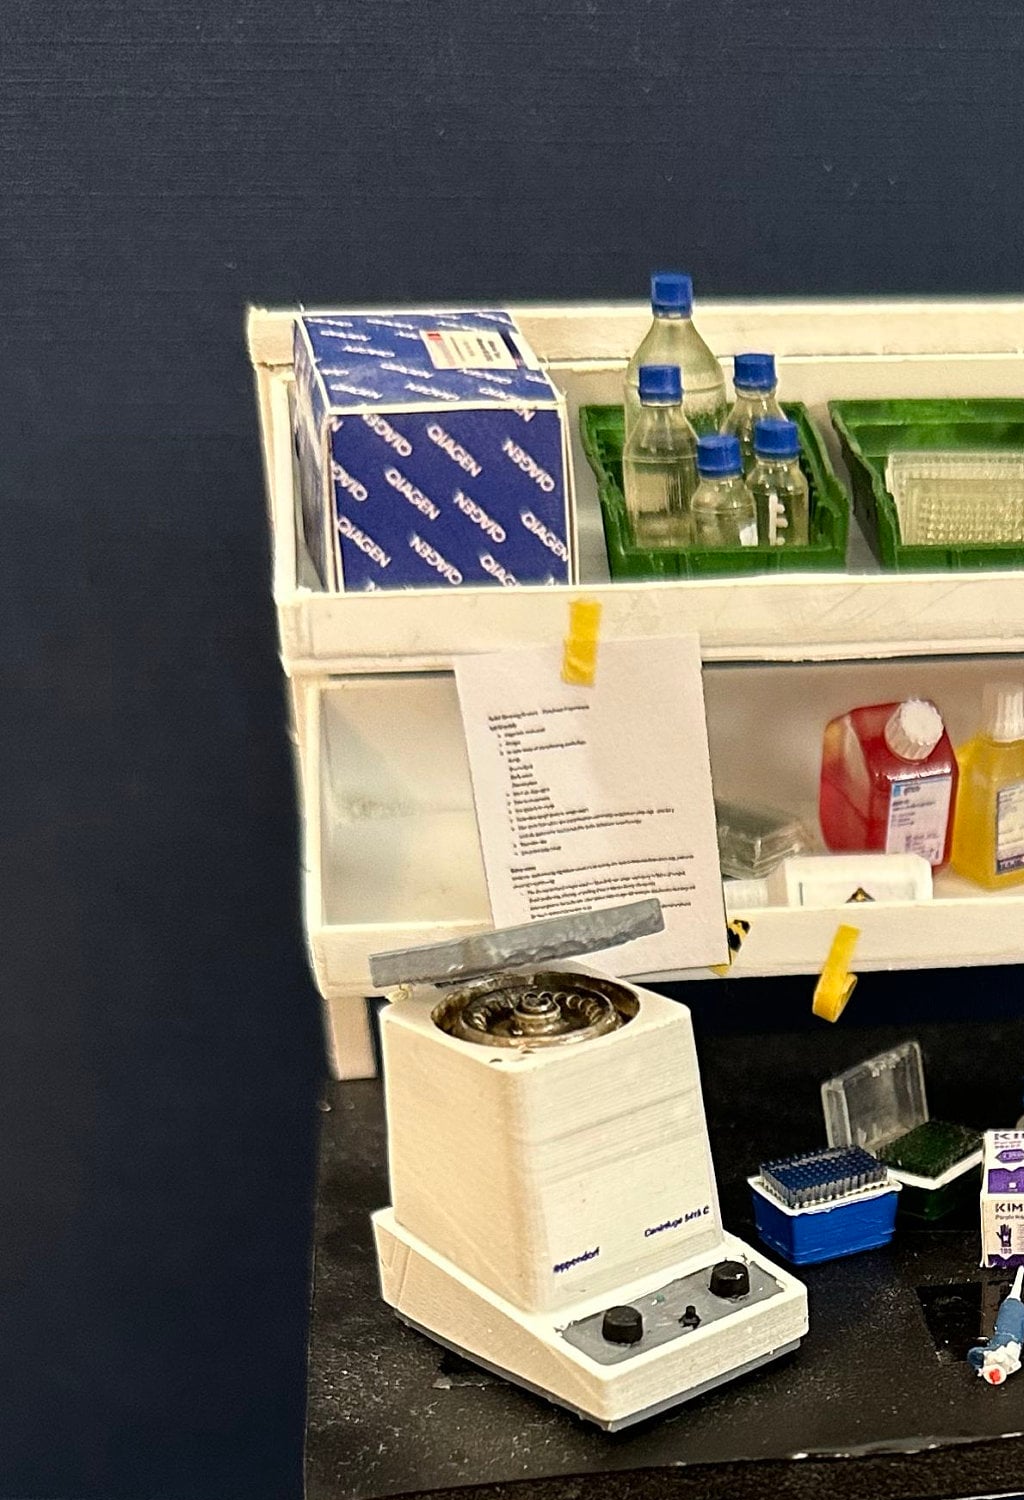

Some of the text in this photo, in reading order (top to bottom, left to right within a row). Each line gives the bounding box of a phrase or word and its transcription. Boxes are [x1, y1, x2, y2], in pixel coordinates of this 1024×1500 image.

[362, 414, 413, 457] QIAGE
[427, 424, 483, 477] QIAGEN
[503, 438, 555, 492] QIAGEN
[385, 468, 441, 520] QIAGEN
[453, 491, 507, 543] QIAGEN
[338, 517, 391, 568] QIAGEN
[409, 535, 463, 585] QIAGEN
[480, 554, 521, 587] QIAG
[702, 1206, 710, 1215] C
[553, 1246, 600, 1273] eppendorf
